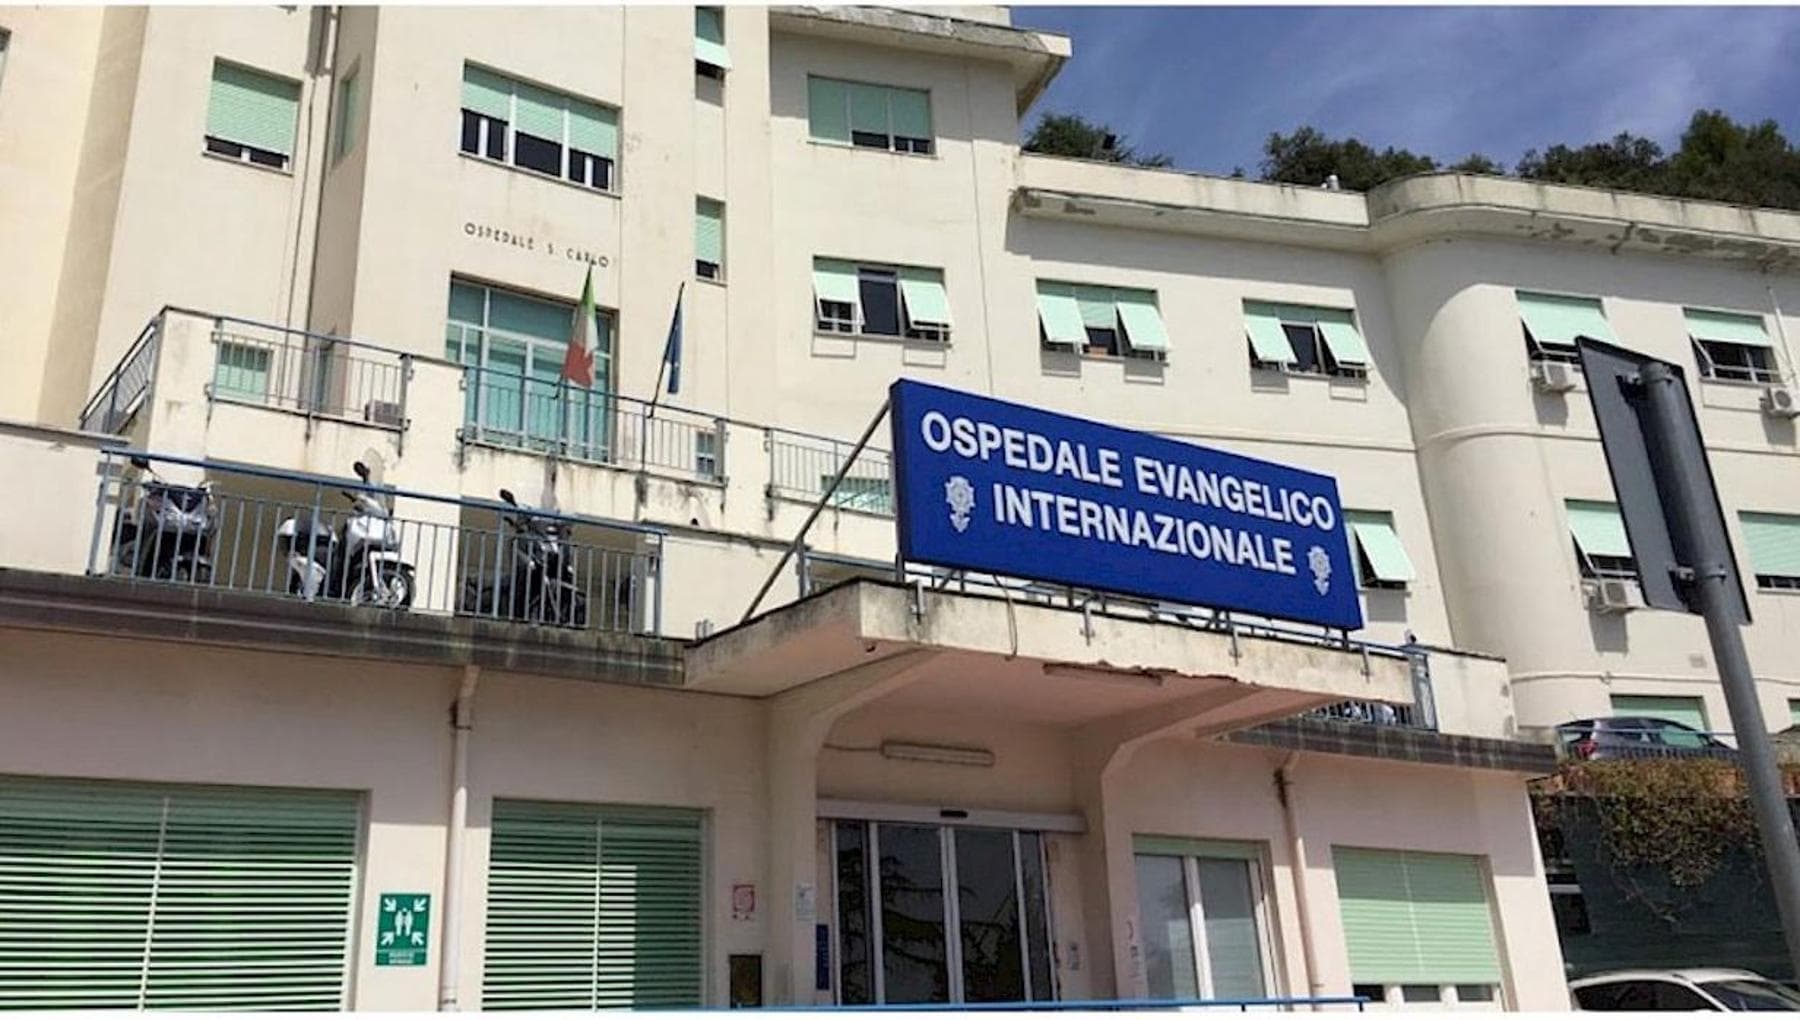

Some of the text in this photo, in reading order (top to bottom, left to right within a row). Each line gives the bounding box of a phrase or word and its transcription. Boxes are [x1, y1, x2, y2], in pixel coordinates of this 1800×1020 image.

[464, 222, 535, 250] OSPEDALE
[921, 411, 1335, 531] OSPEDALE EVANGELICO
[993, 483, 1296, 575] INTERNAZIONALE
